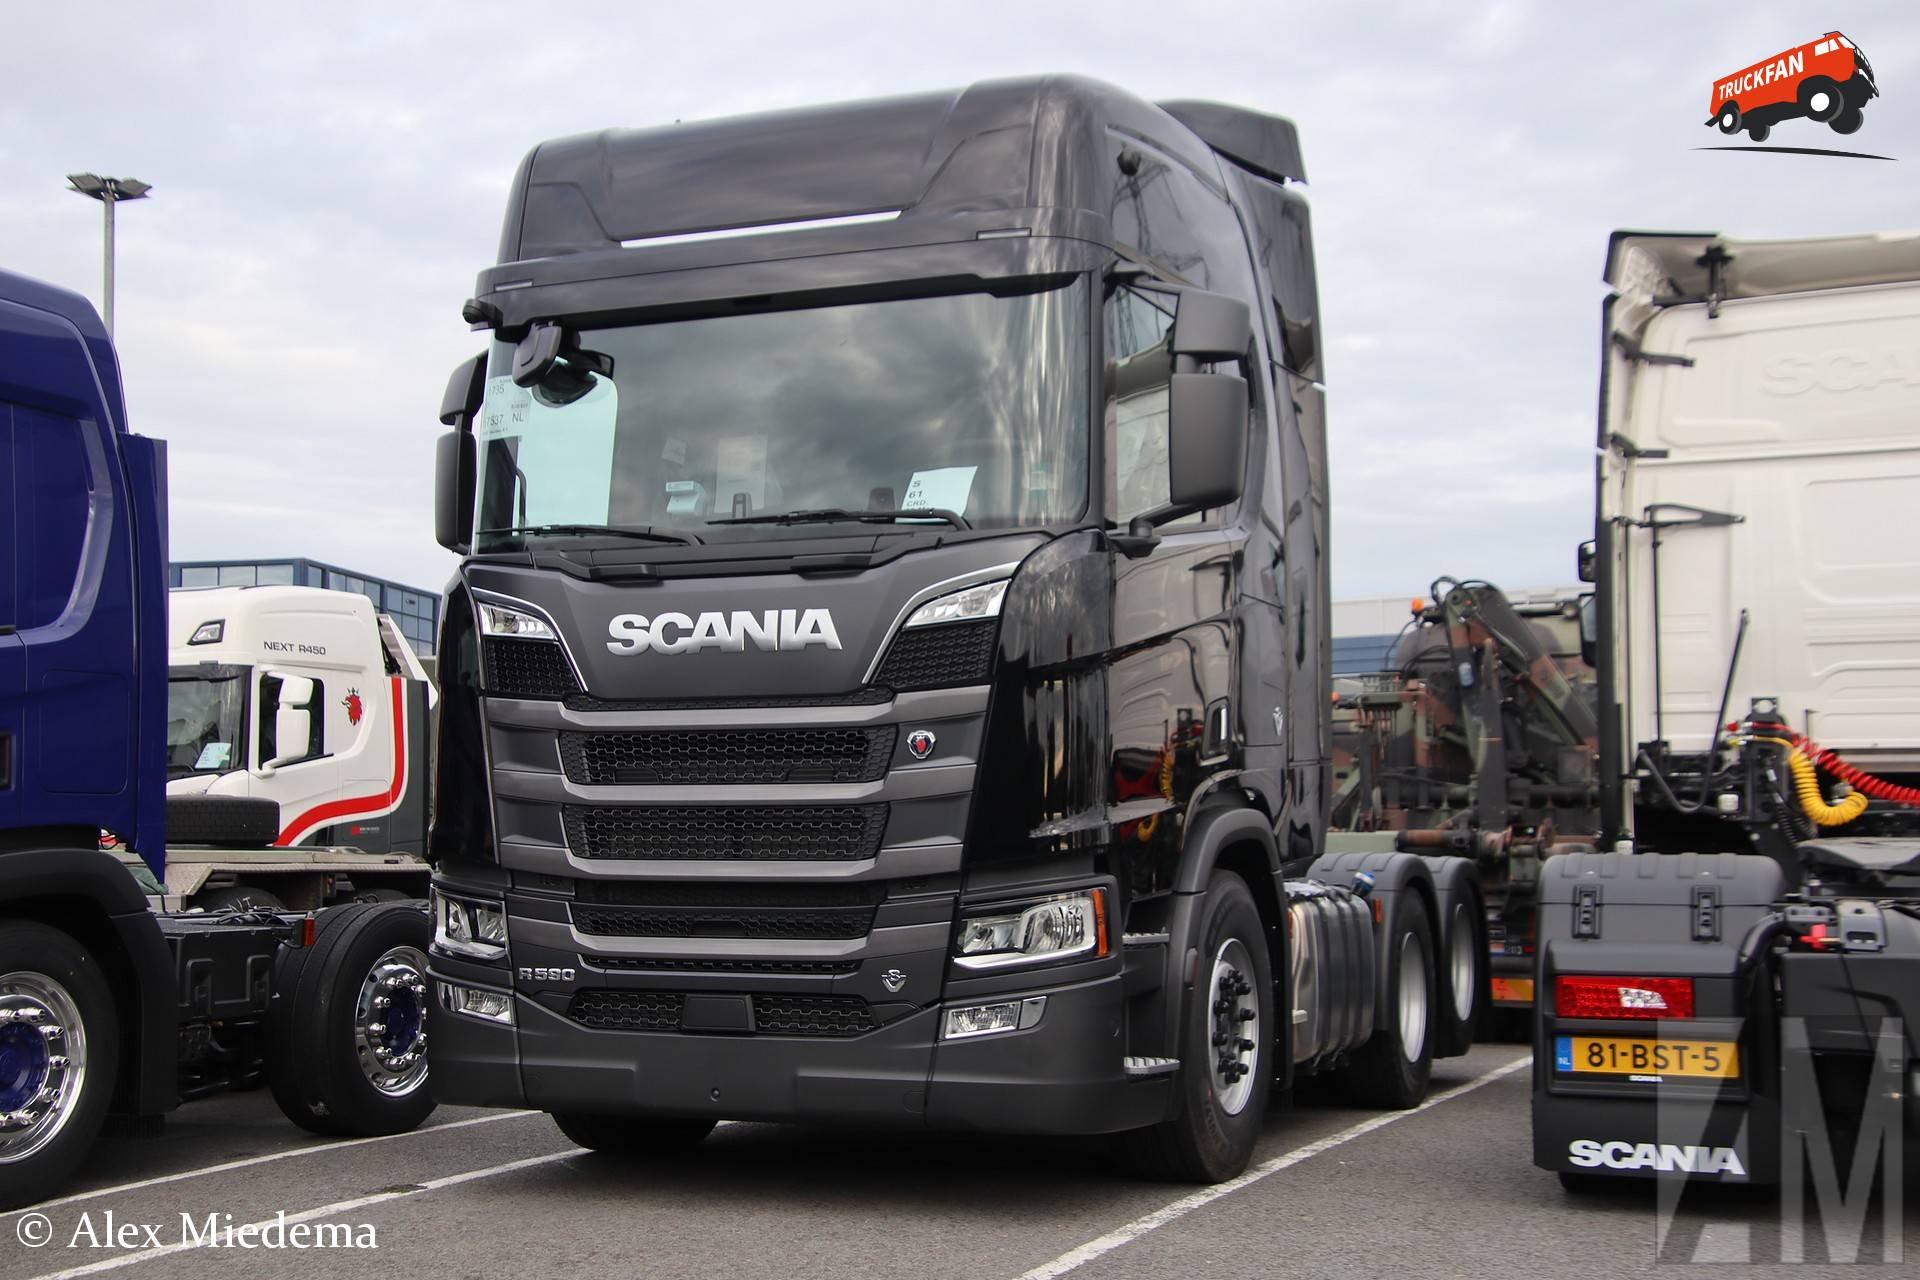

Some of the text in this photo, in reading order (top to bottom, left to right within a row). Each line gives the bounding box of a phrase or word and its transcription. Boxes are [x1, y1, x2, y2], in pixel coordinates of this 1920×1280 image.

[512, 412, 524, 422] NL
[606, 608, 843, 656] SCANIA
[263, 641, 326, 655] NEXT R450
[1557, 1056, 1571, 1066] NL
[1587, 1042, 1720, 1072] 81-BST-5
[1569, 1140, 1746, 1175] SCANIA
